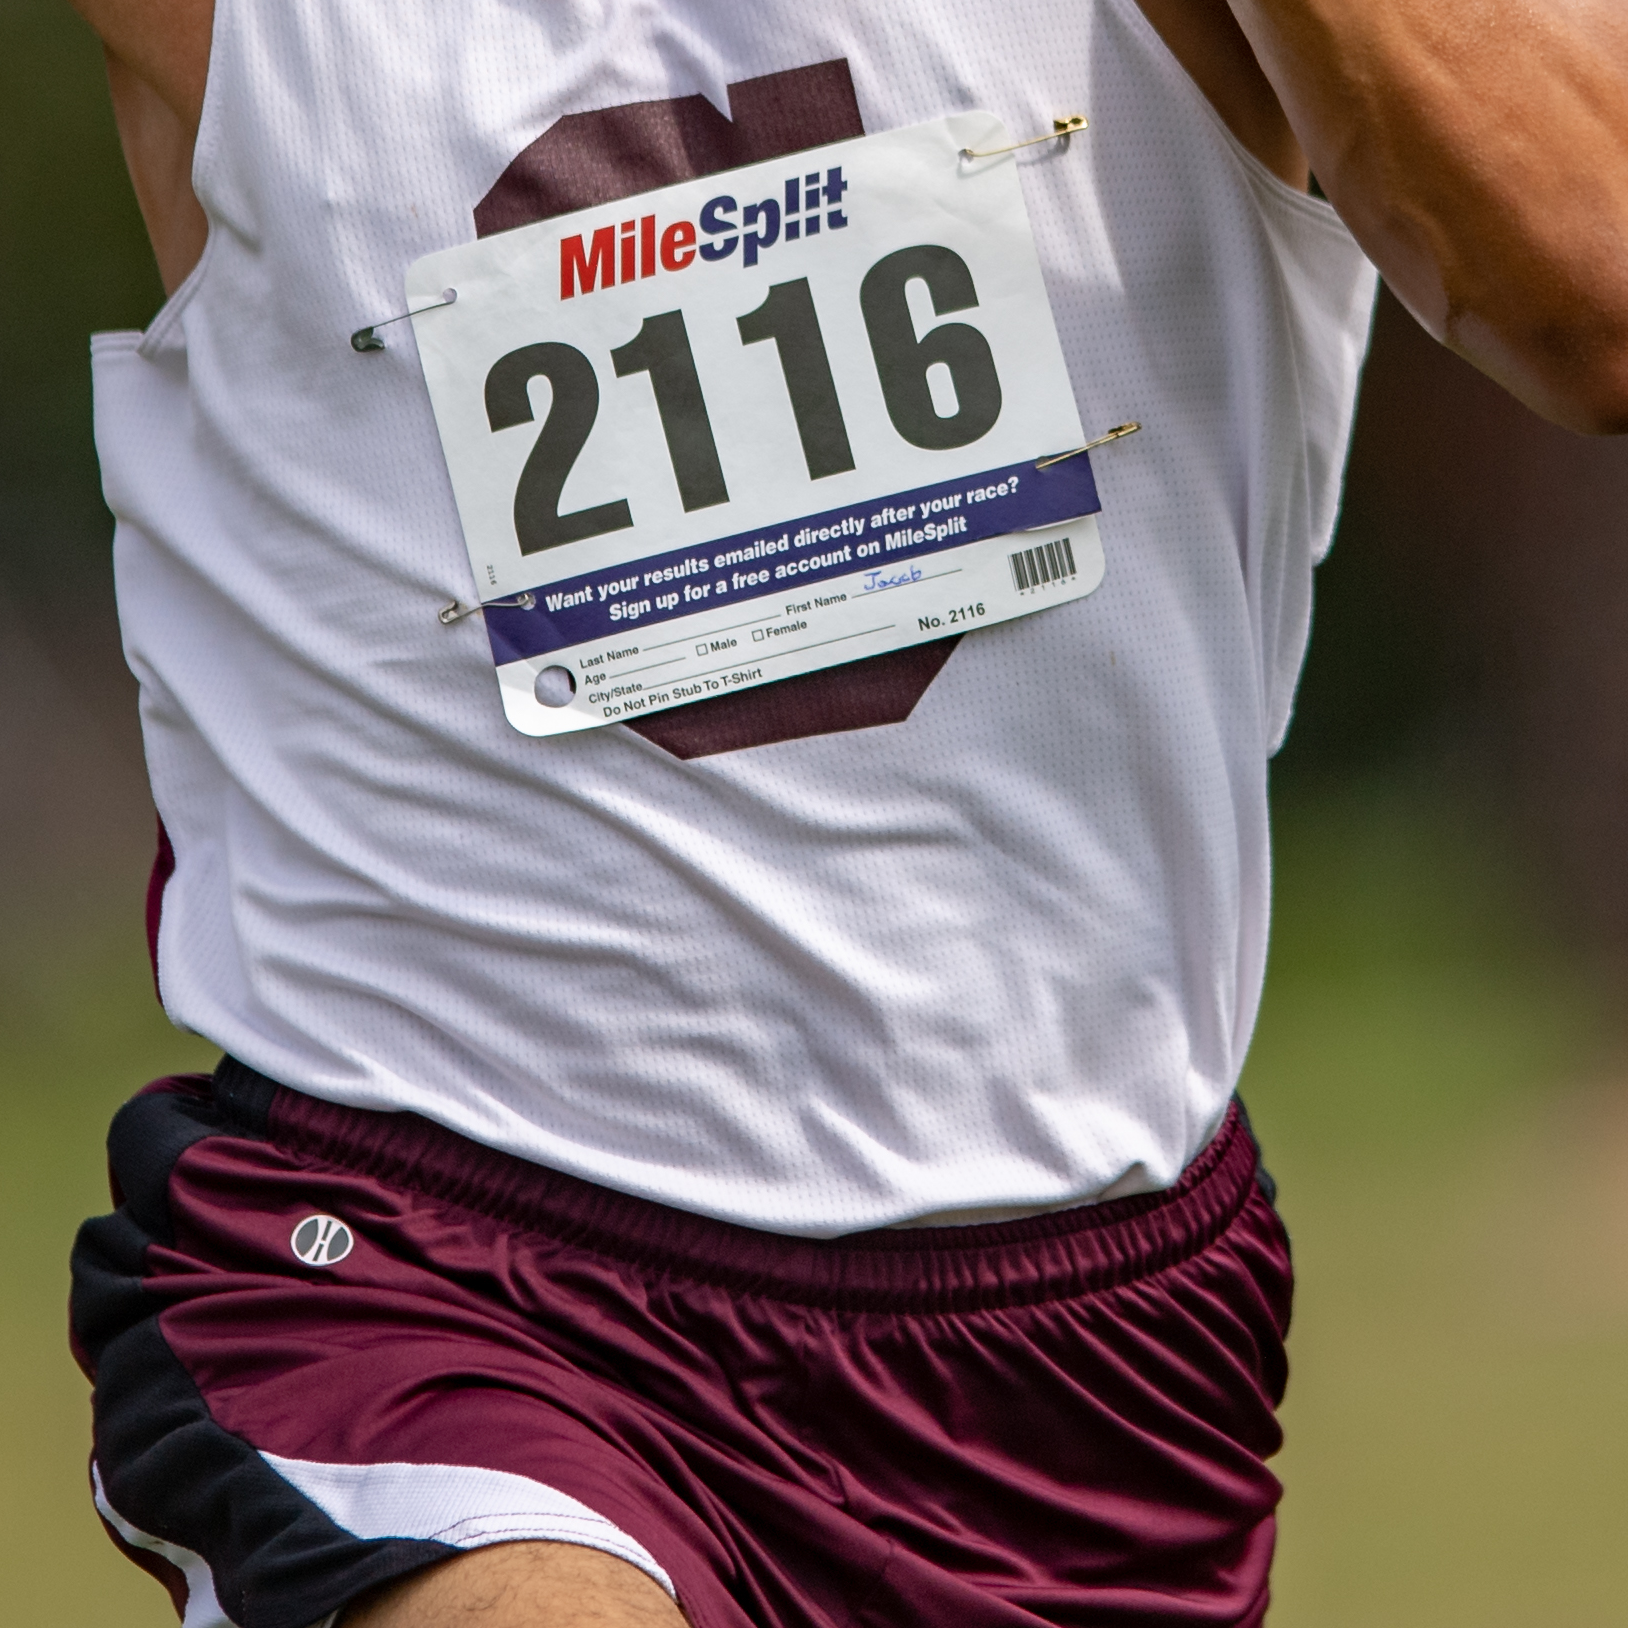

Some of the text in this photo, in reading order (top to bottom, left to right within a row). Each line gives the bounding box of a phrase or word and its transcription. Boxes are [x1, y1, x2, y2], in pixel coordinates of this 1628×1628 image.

[560, 166, 848, 301] MileSplit
[484, 243, 1004, 557] 2116
[545, 476, 1020, 612] Want your results emailed directly after your race?
[609, 515, 968, 621] Sign up for a free account on MileSplit
[785, 592, 847, 616] First Name
[918, 602, 986, 631] No. 2116
[766, 619, 807, 638] Female
[579, 646, 639, 669] Last Name
[709, 637, 738, 653] Male
[584, 671, 607, 686] Age
[588, 682, 643, 704] City/State
[603, 668, 763, 718] Do Not Pin Stub To T-Shirt
